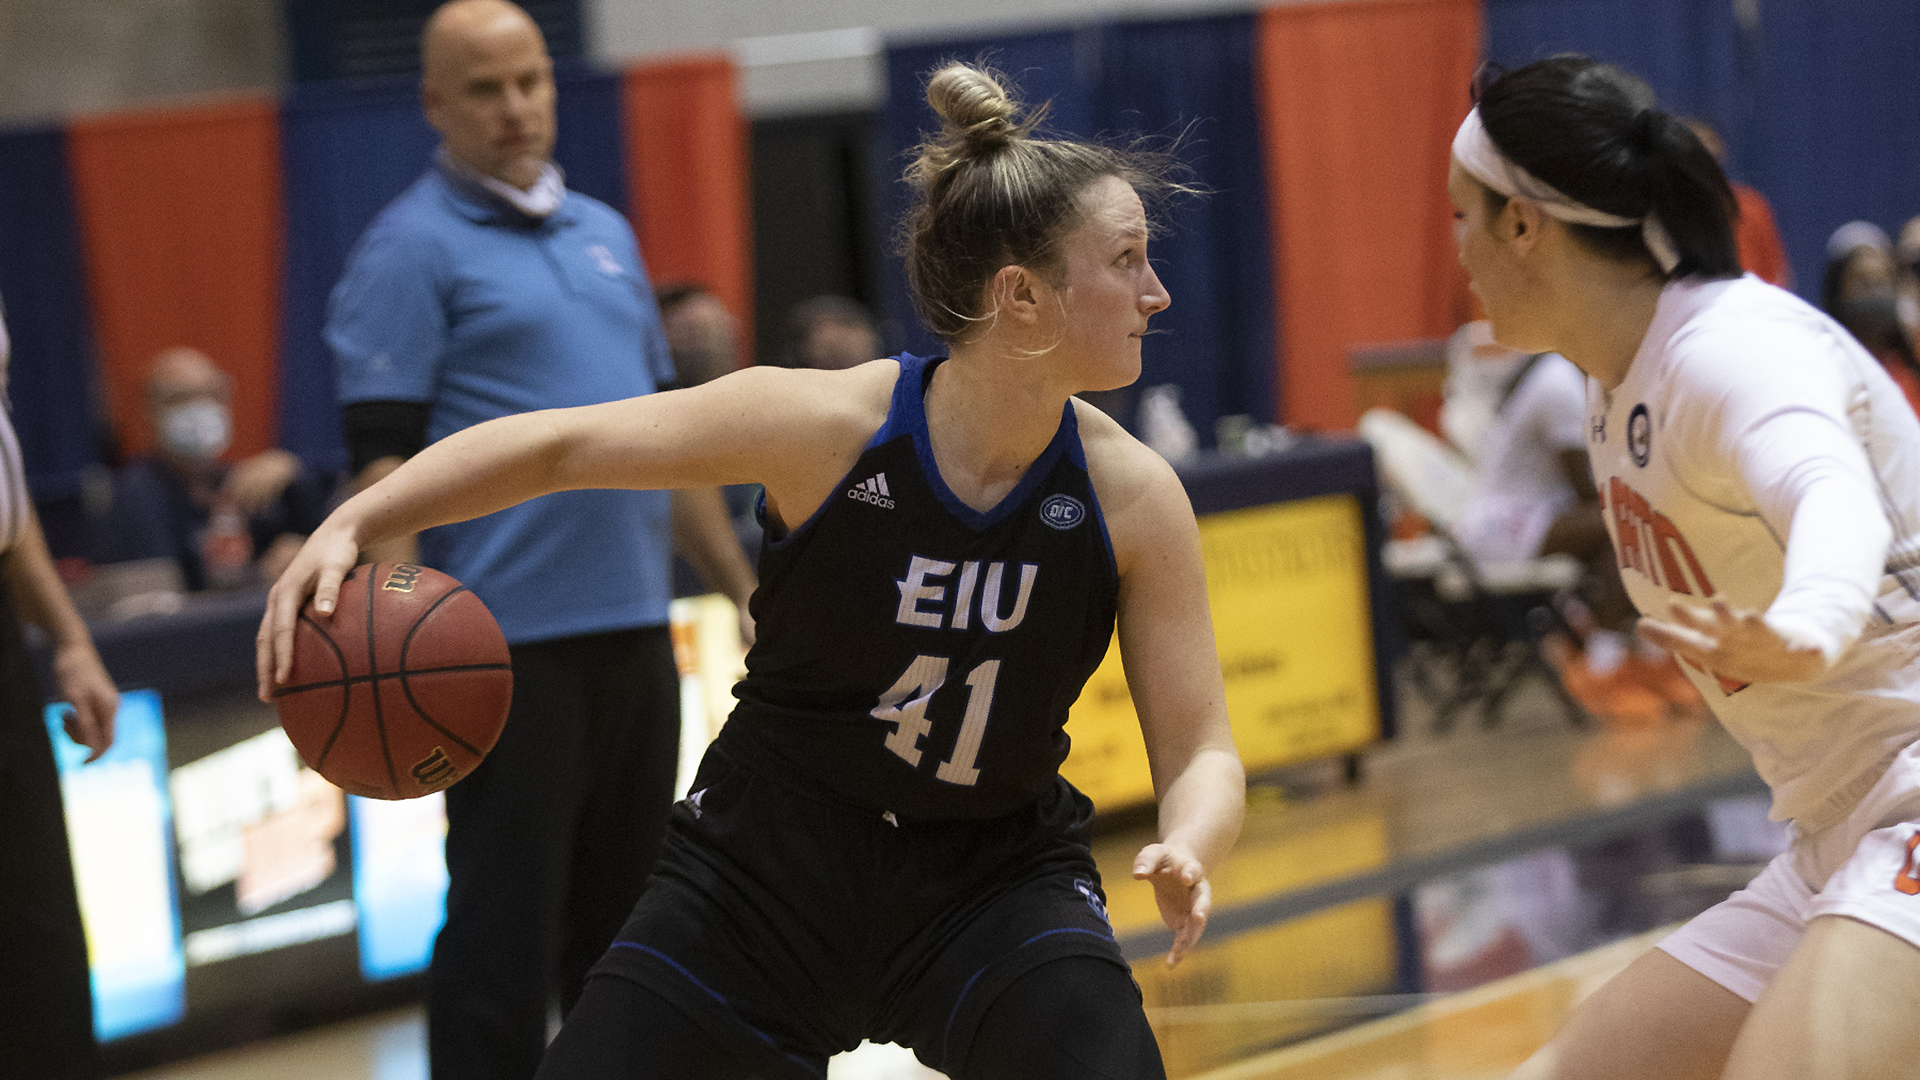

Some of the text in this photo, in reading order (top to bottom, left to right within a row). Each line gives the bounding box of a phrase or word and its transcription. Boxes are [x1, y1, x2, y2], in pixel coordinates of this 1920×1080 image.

[847, 489, 896, 510] adidas
[382, 563, 423, 593] on
[894, 554, 1040, 633] EIU
[868, 653, 1002, 787] 41
